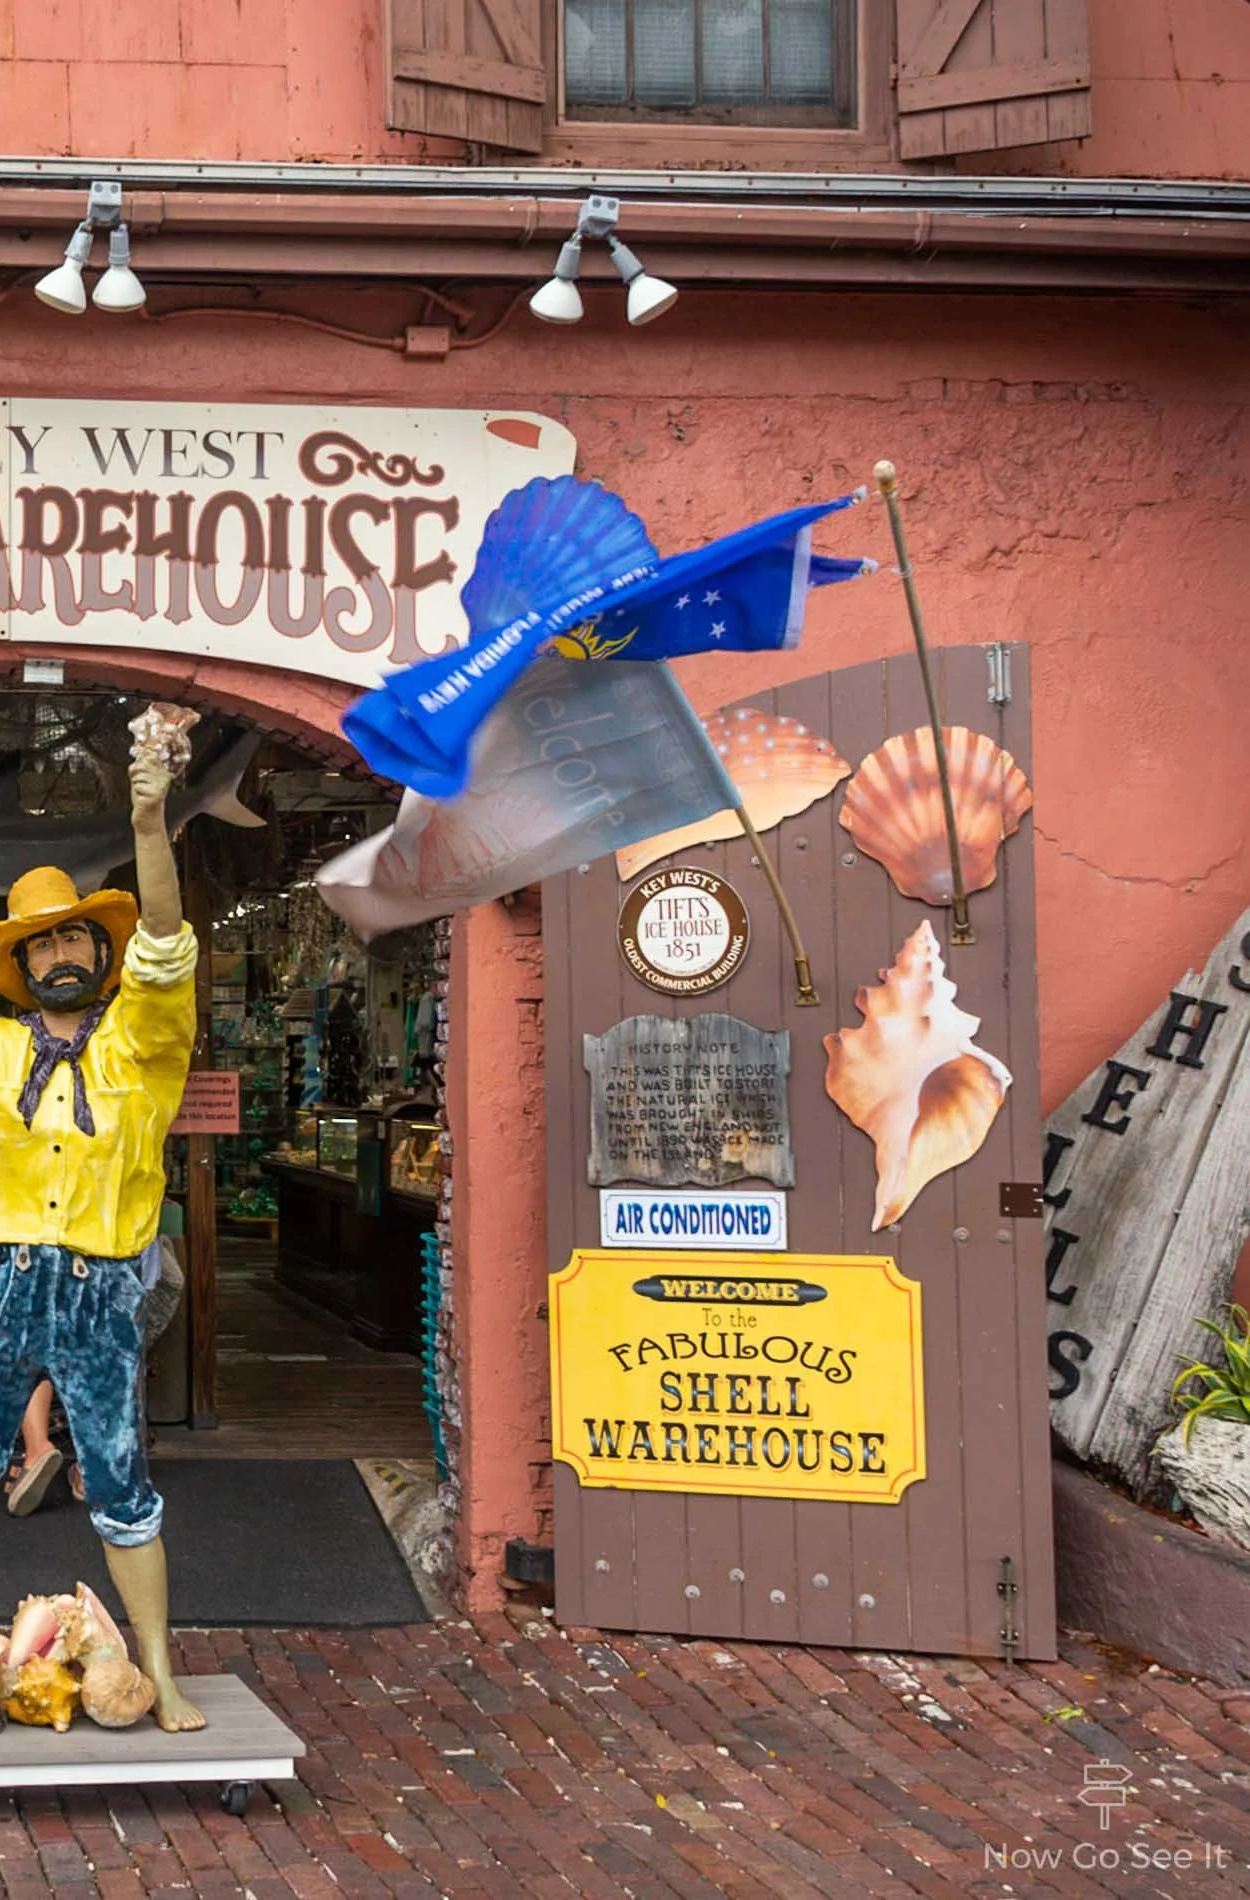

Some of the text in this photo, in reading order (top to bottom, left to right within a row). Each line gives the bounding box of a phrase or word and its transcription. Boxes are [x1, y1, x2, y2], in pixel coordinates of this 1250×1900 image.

[79, 427, 285, 481] WEST
[640, 871, 721, 899] KEY WEST'S
[645, 919, 724, 939] ICE HOUSE
[623, 937, 648, 974] OLDEST
[645, 970, 713, 990] COMMERCIAL
[710, 935, 745, 980] BUILDING
[665, 939, 701, 961] 1851
[615, 1202, 772, 1236] AIR CONDITIONED
[659, 1278, 799, 1301] WELCOME
[701, 1308, 758, 1328] To the
[608, 1332, 857, 1385] FABULOUS
[659, 1371, 811, 1418] SHELL
[582, 1417, 886, 1475] WAREHOUSE
